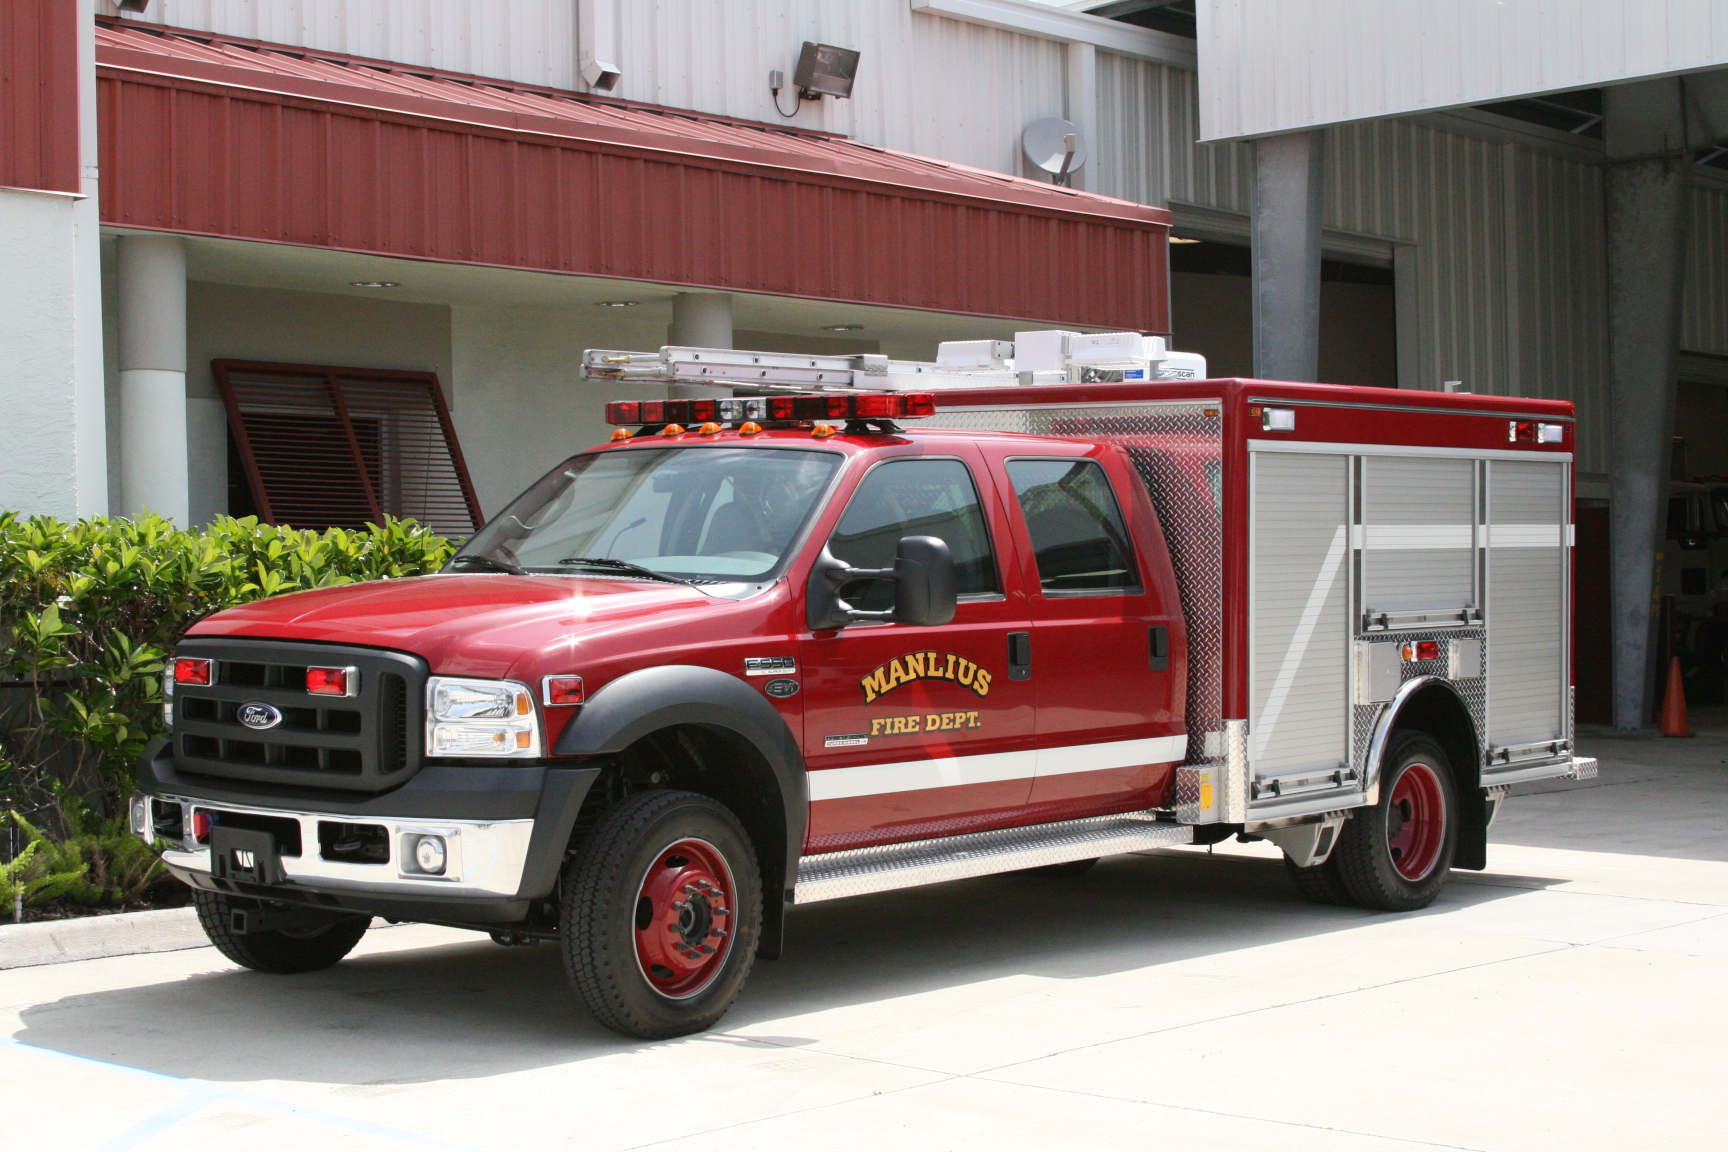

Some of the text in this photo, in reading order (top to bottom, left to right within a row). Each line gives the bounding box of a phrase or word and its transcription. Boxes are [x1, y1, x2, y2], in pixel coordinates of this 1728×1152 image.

[859, 651, 993, 705] MANLIUS
[244, 706, 269, 724] Ford
[870, 710, 982, 736] FIRE DEPT.
